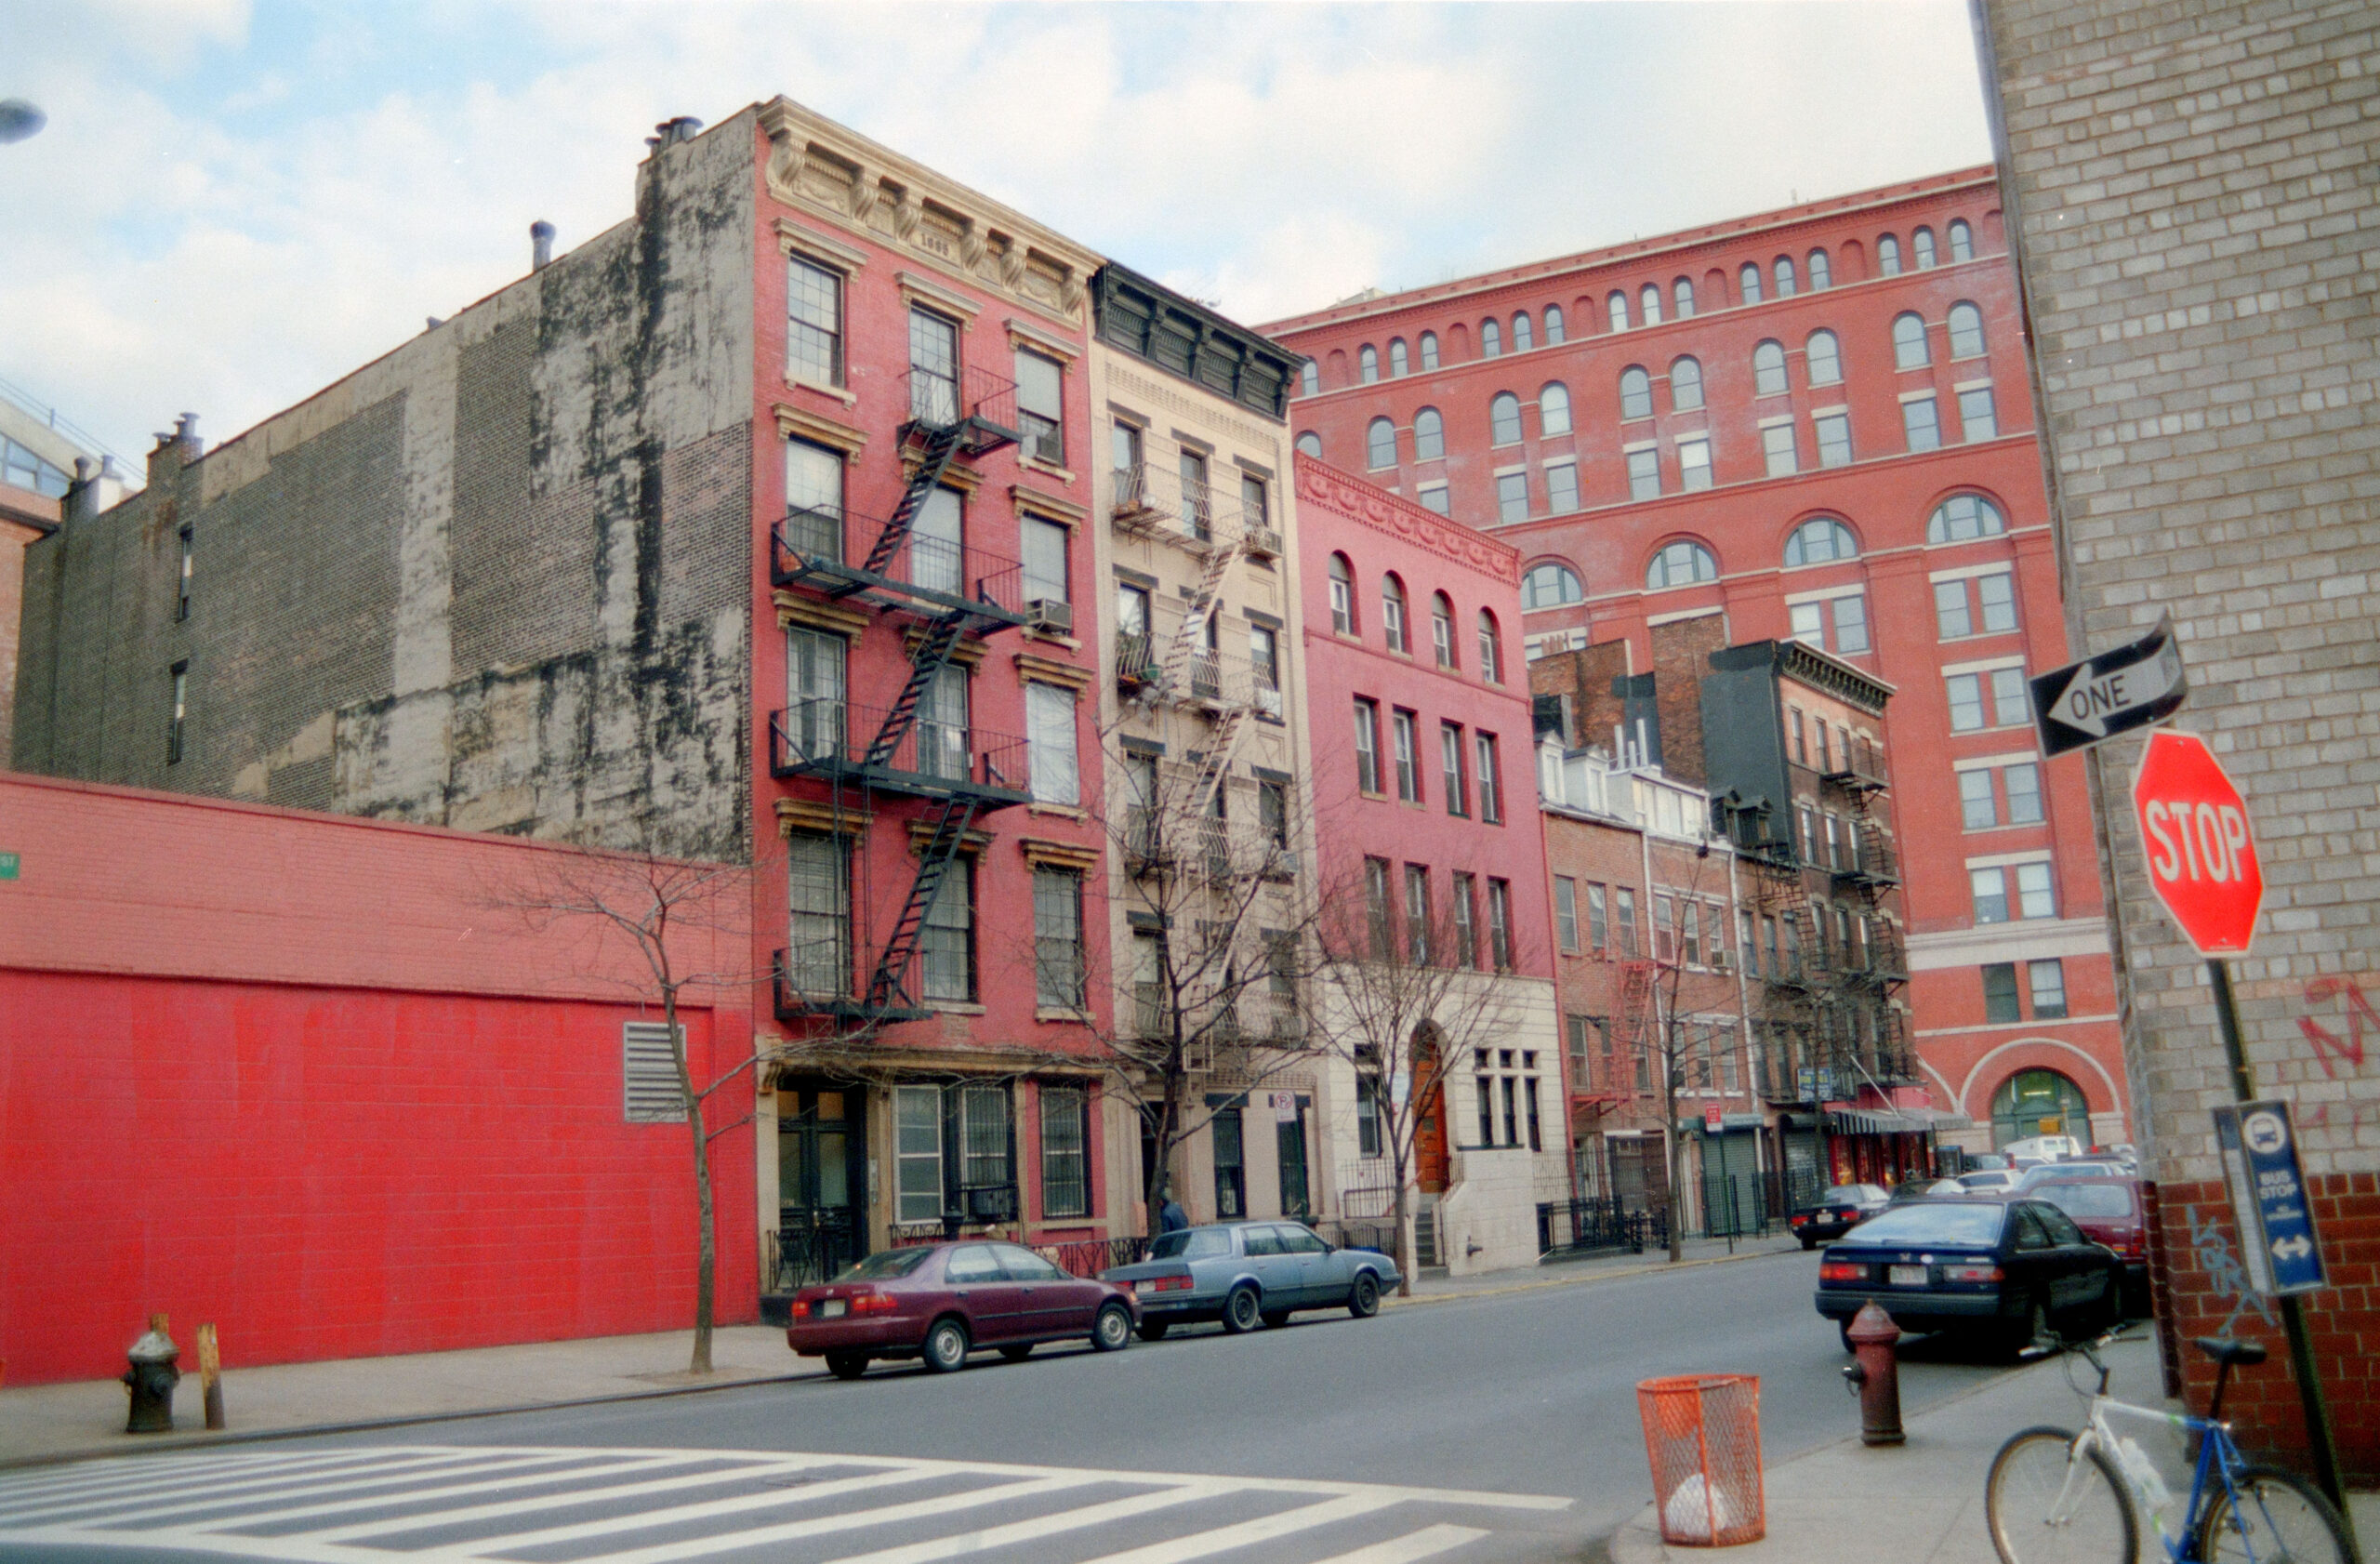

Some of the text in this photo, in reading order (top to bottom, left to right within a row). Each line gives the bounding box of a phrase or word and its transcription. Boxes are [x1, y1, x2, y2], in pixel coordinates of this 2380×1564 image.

[2069, 674, 2132, 721] ONE
[2146, 799, 2246, 882] STOP
[2258, 1183, 2298, 1200] STOP
[2259, 1170, 2292, 1186] BUS
